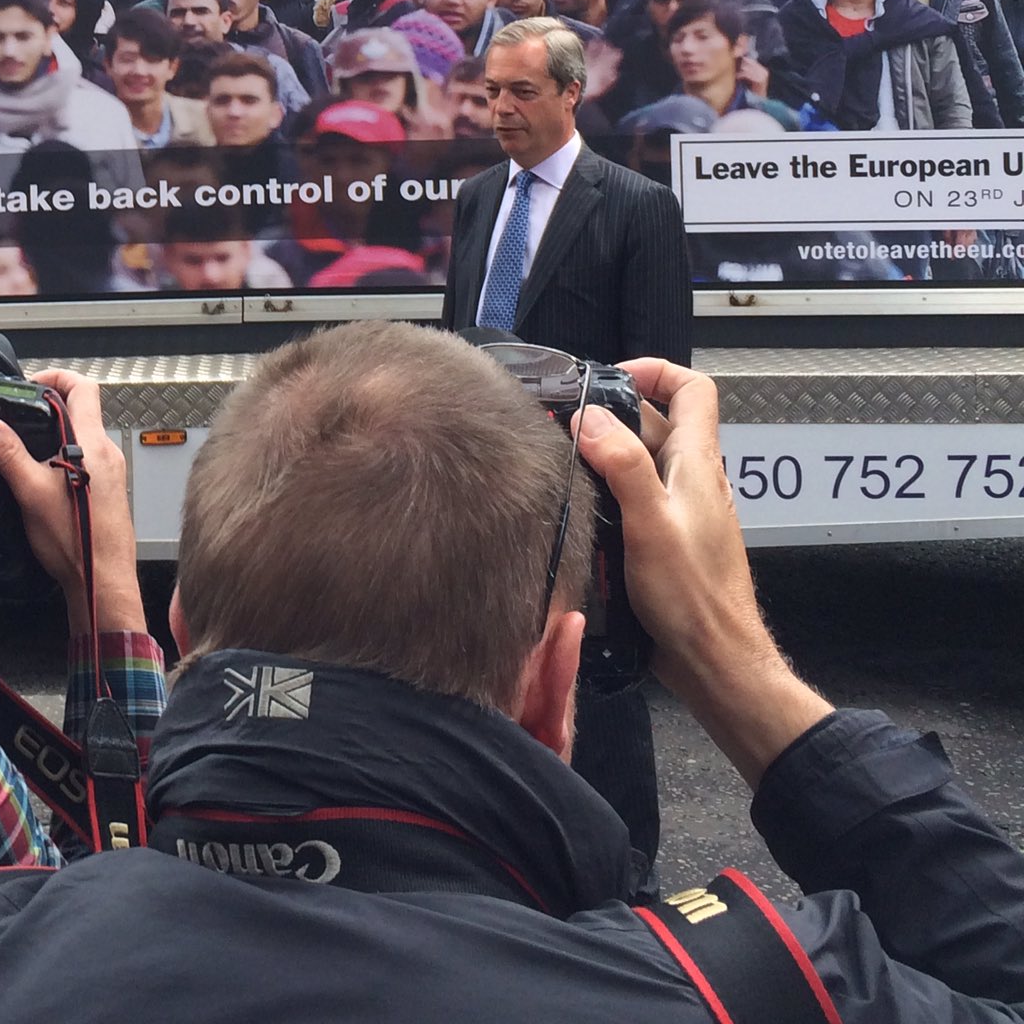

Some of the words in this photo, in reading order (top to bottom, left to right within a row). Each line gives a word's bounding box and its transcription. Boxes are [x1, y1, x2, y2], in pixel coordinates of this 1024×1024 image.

[694, 156, 780, 180] Leave
[790, 154, 837, 178] the
[849, 153, 991, 182] European
[1003, 151, 1024, 177] U
[89, 179, 183, 210] back
[194, 175, 334, 207] control
[347, 174, 387, 202] of
[399, 178, 467, 201] our
[894, 190, 933, 208] ON
[947, 188, 1004, 208] 23RD
[721, 454, 803, 500] 50
[824, 454, 926, 499] 752
[14, 723, 87, 804] EOS
[176, 838, 342, 884] Canon
